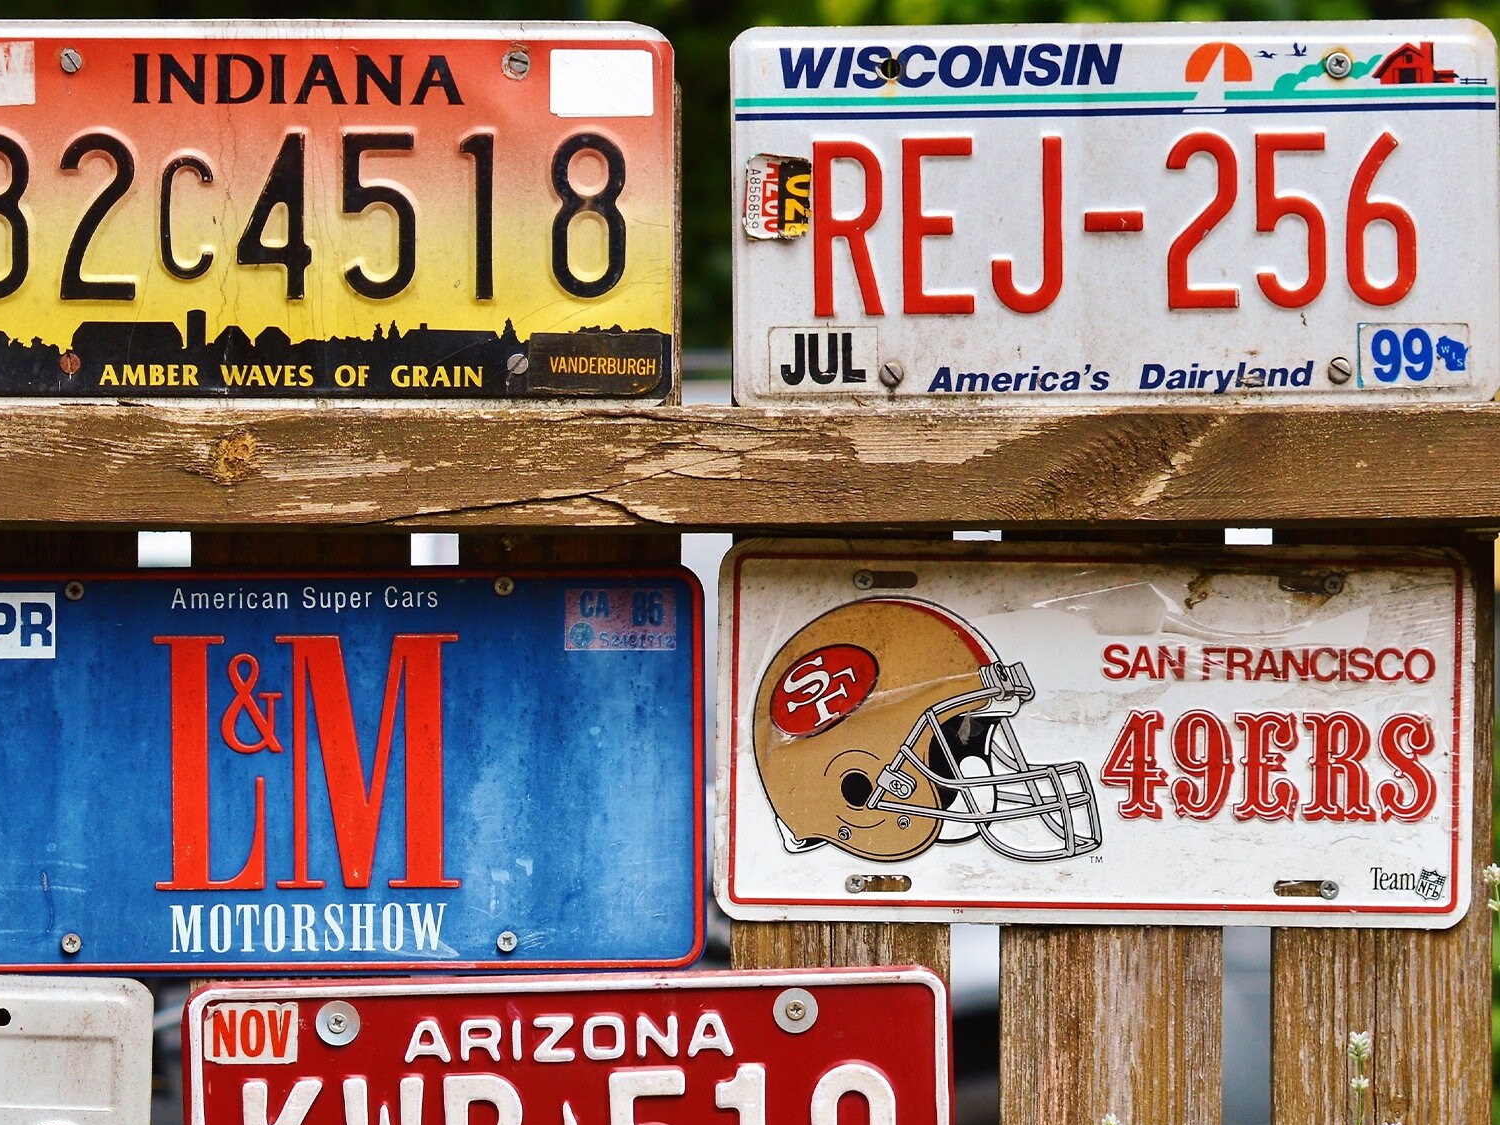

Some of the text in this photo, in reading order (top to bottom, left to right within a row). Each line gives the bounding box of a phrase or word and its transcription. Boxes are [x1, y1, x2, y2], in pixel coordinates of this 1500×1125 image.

[132, 52, 465, 106] INDIANA
[780, 43, 1122, 89] WISCONSIN
[813, 131, 1417, 317] REJ-256
[99, 363, 484, 389] AMBER WAVES OF GRAIN
[548, 354, 657, 375] VANDERBURGH
[781, 333, 867, 385] JUL
[927, 361, 1313, 394] America's Dairyland
[1371, 328, 1464, 382] 99 WIS
[172, 587, 439, 613] American Super Cars
[580, 590, 610, 618] CA
[1102, 645, 1435, 683] SAN FRANCISCO
[784, 656, 856, 727] SF
[154, 634, 460, 891] L&M
[1102, 710, 1437, 823] 49ERS
[1369, 866, 1416, 890] Team
[170, 903, 448, 954] MOTORSHOW
[211, 1008, 291, 1059] NOV
[404, 1013, 734, 1063] ARIZONA
